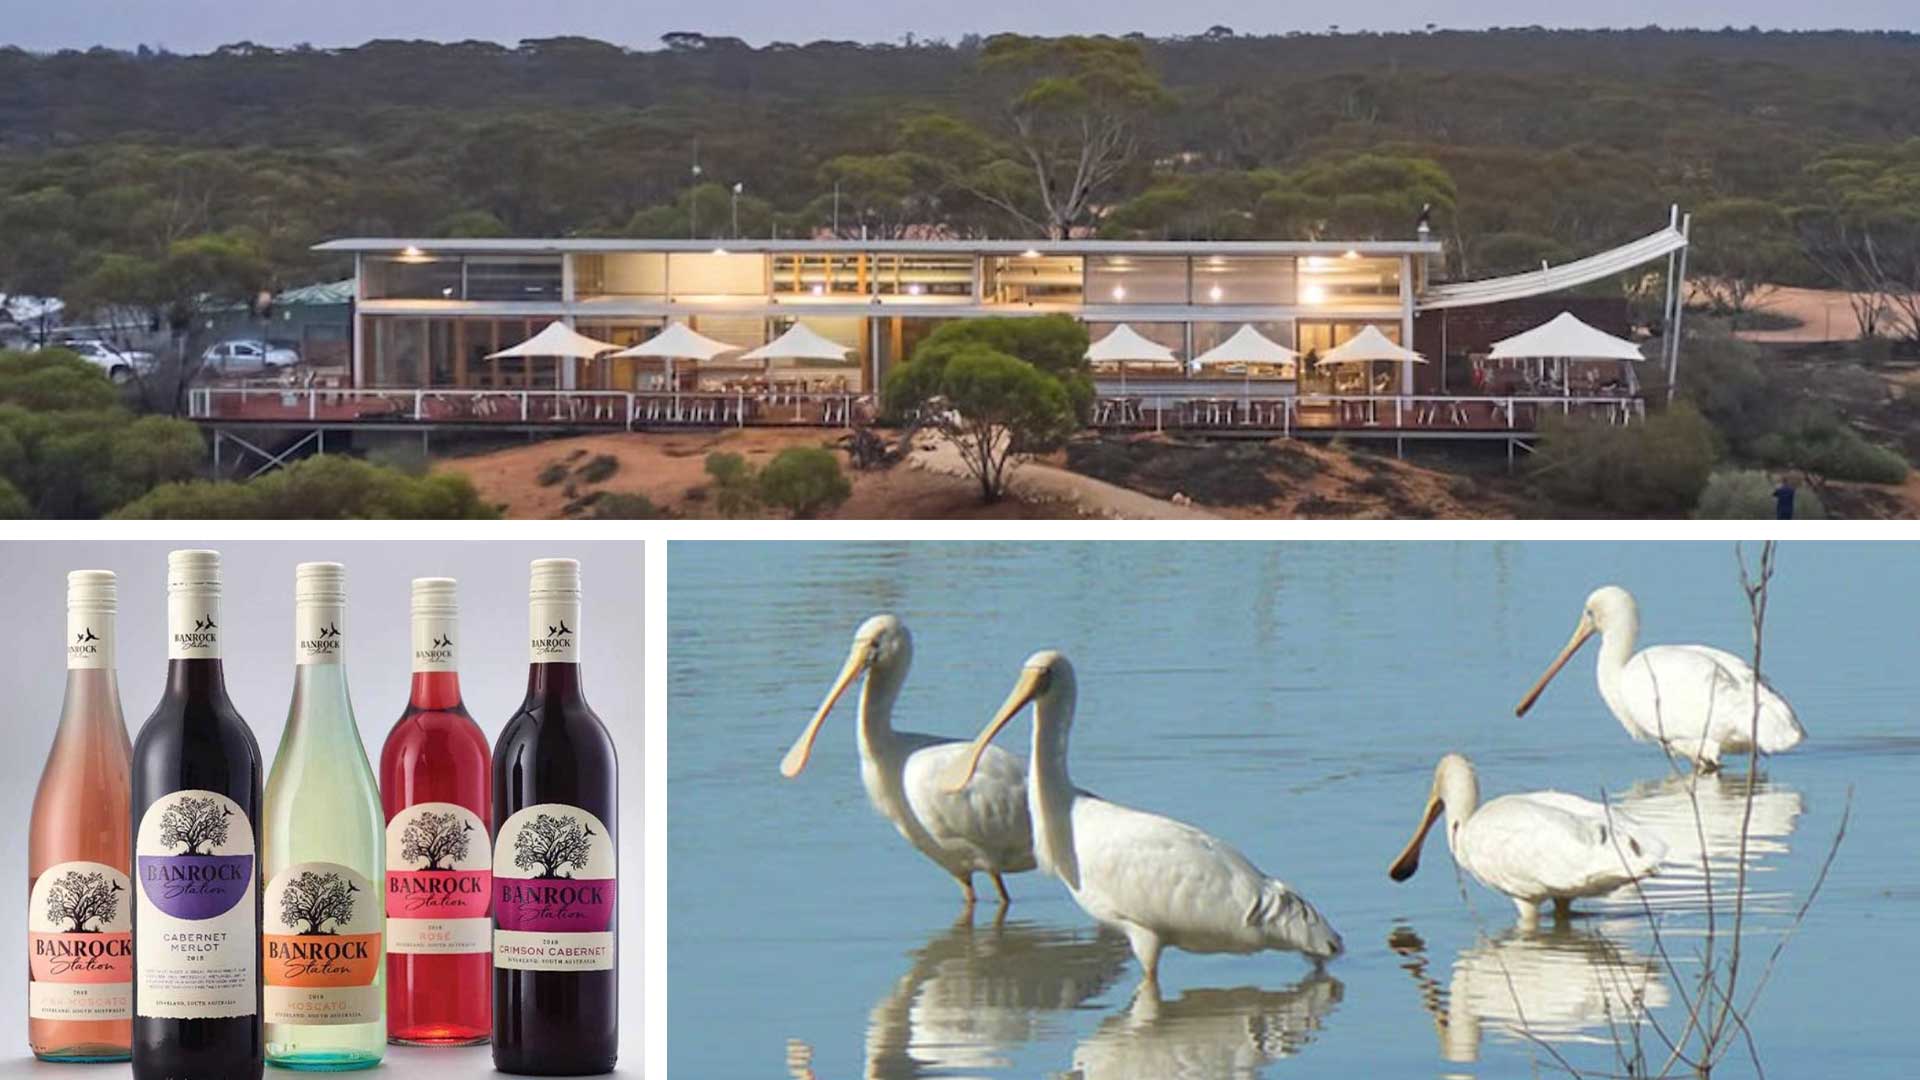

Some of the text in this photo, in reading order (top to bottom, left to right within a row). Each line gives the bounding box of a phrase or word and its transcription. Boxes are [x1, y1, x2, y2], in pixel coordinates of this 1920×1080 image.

[174, 633, 217, 642] BANROCK
[300, 640, 340, 649] BANROCK
[531, 639, 571, 648] BANROCK
[147, 864, 243, 882] BANROCK
[164, 880, 226, 899] Station
[389, 876, 482, 894] BANROCK
[405, 892, 468, 911] Station
[502, 885, 604, 905] BANROCK
[517, 902, 586, 921] Station
[163, 932, 228, 942] CABERNET
[36, 939, 132, 957] BANROCK
[171, 943, 220, 952] MERLOT
[269, 941, 369, 960] BANROCK
[500, 945, 606, 956] CRIMSON CABERNET
[50, 953, 116, 975] Station
[284, 958, 352, 979] Station
